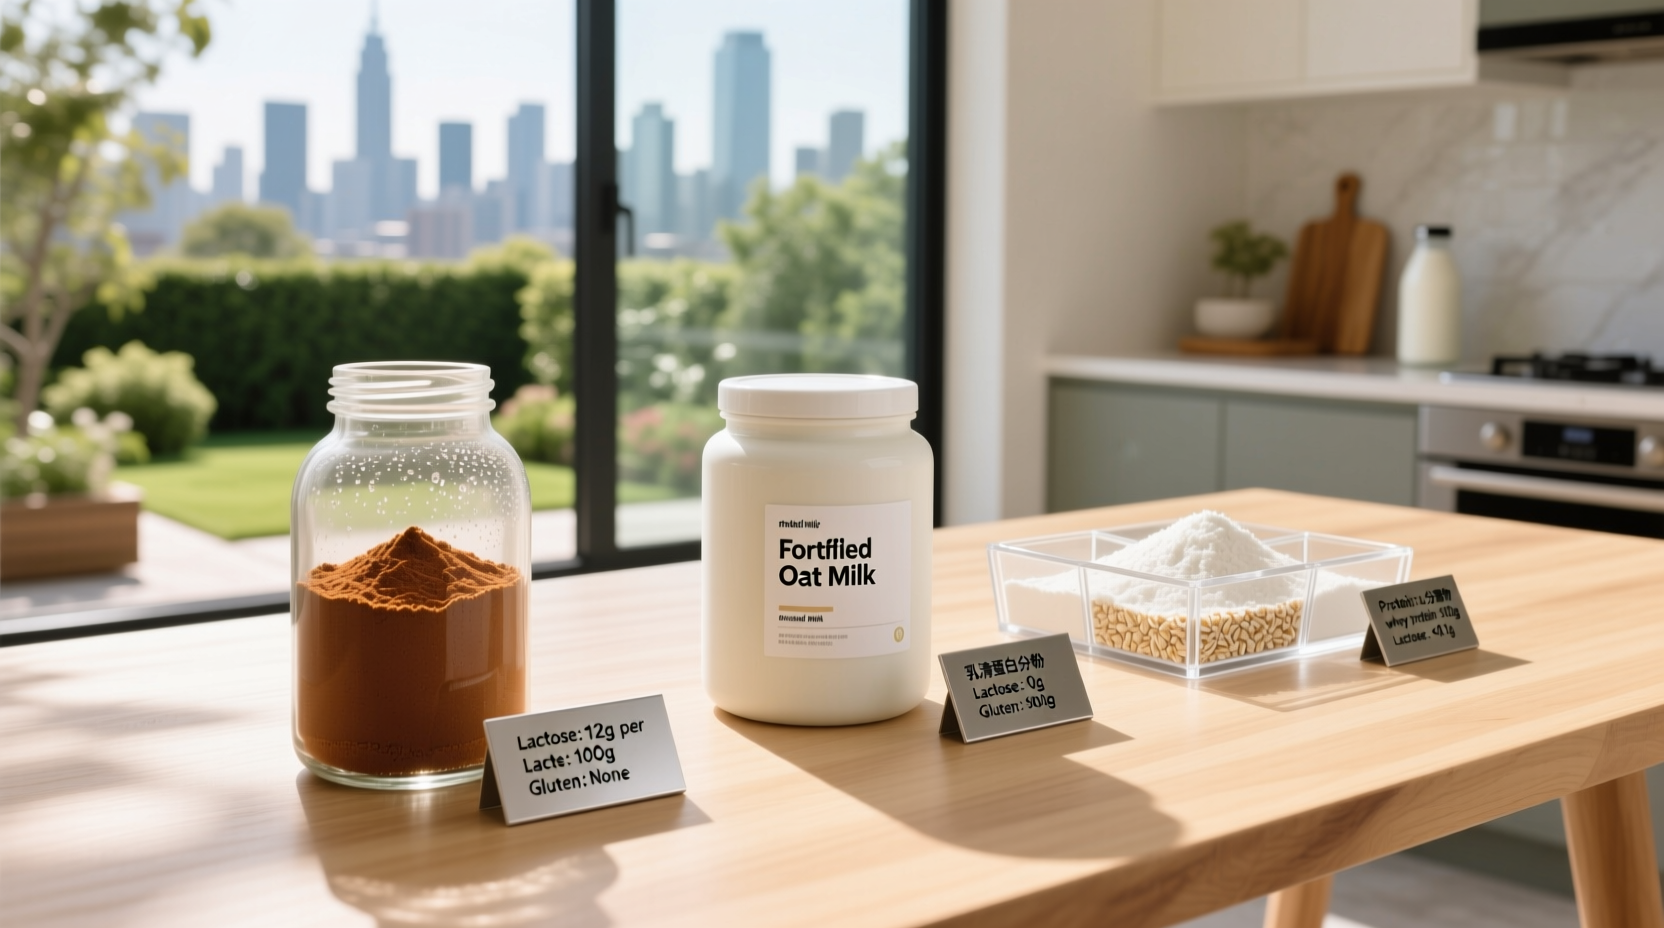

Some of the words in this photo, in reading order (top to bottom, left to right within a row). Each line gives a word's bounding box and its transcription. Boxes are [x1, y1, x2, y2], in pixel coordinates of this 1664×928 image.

[779, 565, 822, 587] Oat
[828, 563, 876, 587] Milk
[1026, 675, 1045, 692] 0g
[979, 701, 1024, 718] Gluten:
[517, 730, 583, 751] Lactose:
[584, 722, 615, 741] 12g
[619, 720, 644, 739] per
[574, 745, 615, 763] 100g
[529, 775, 587, 796] Gluten:
[589, 768, 630, 784] None
